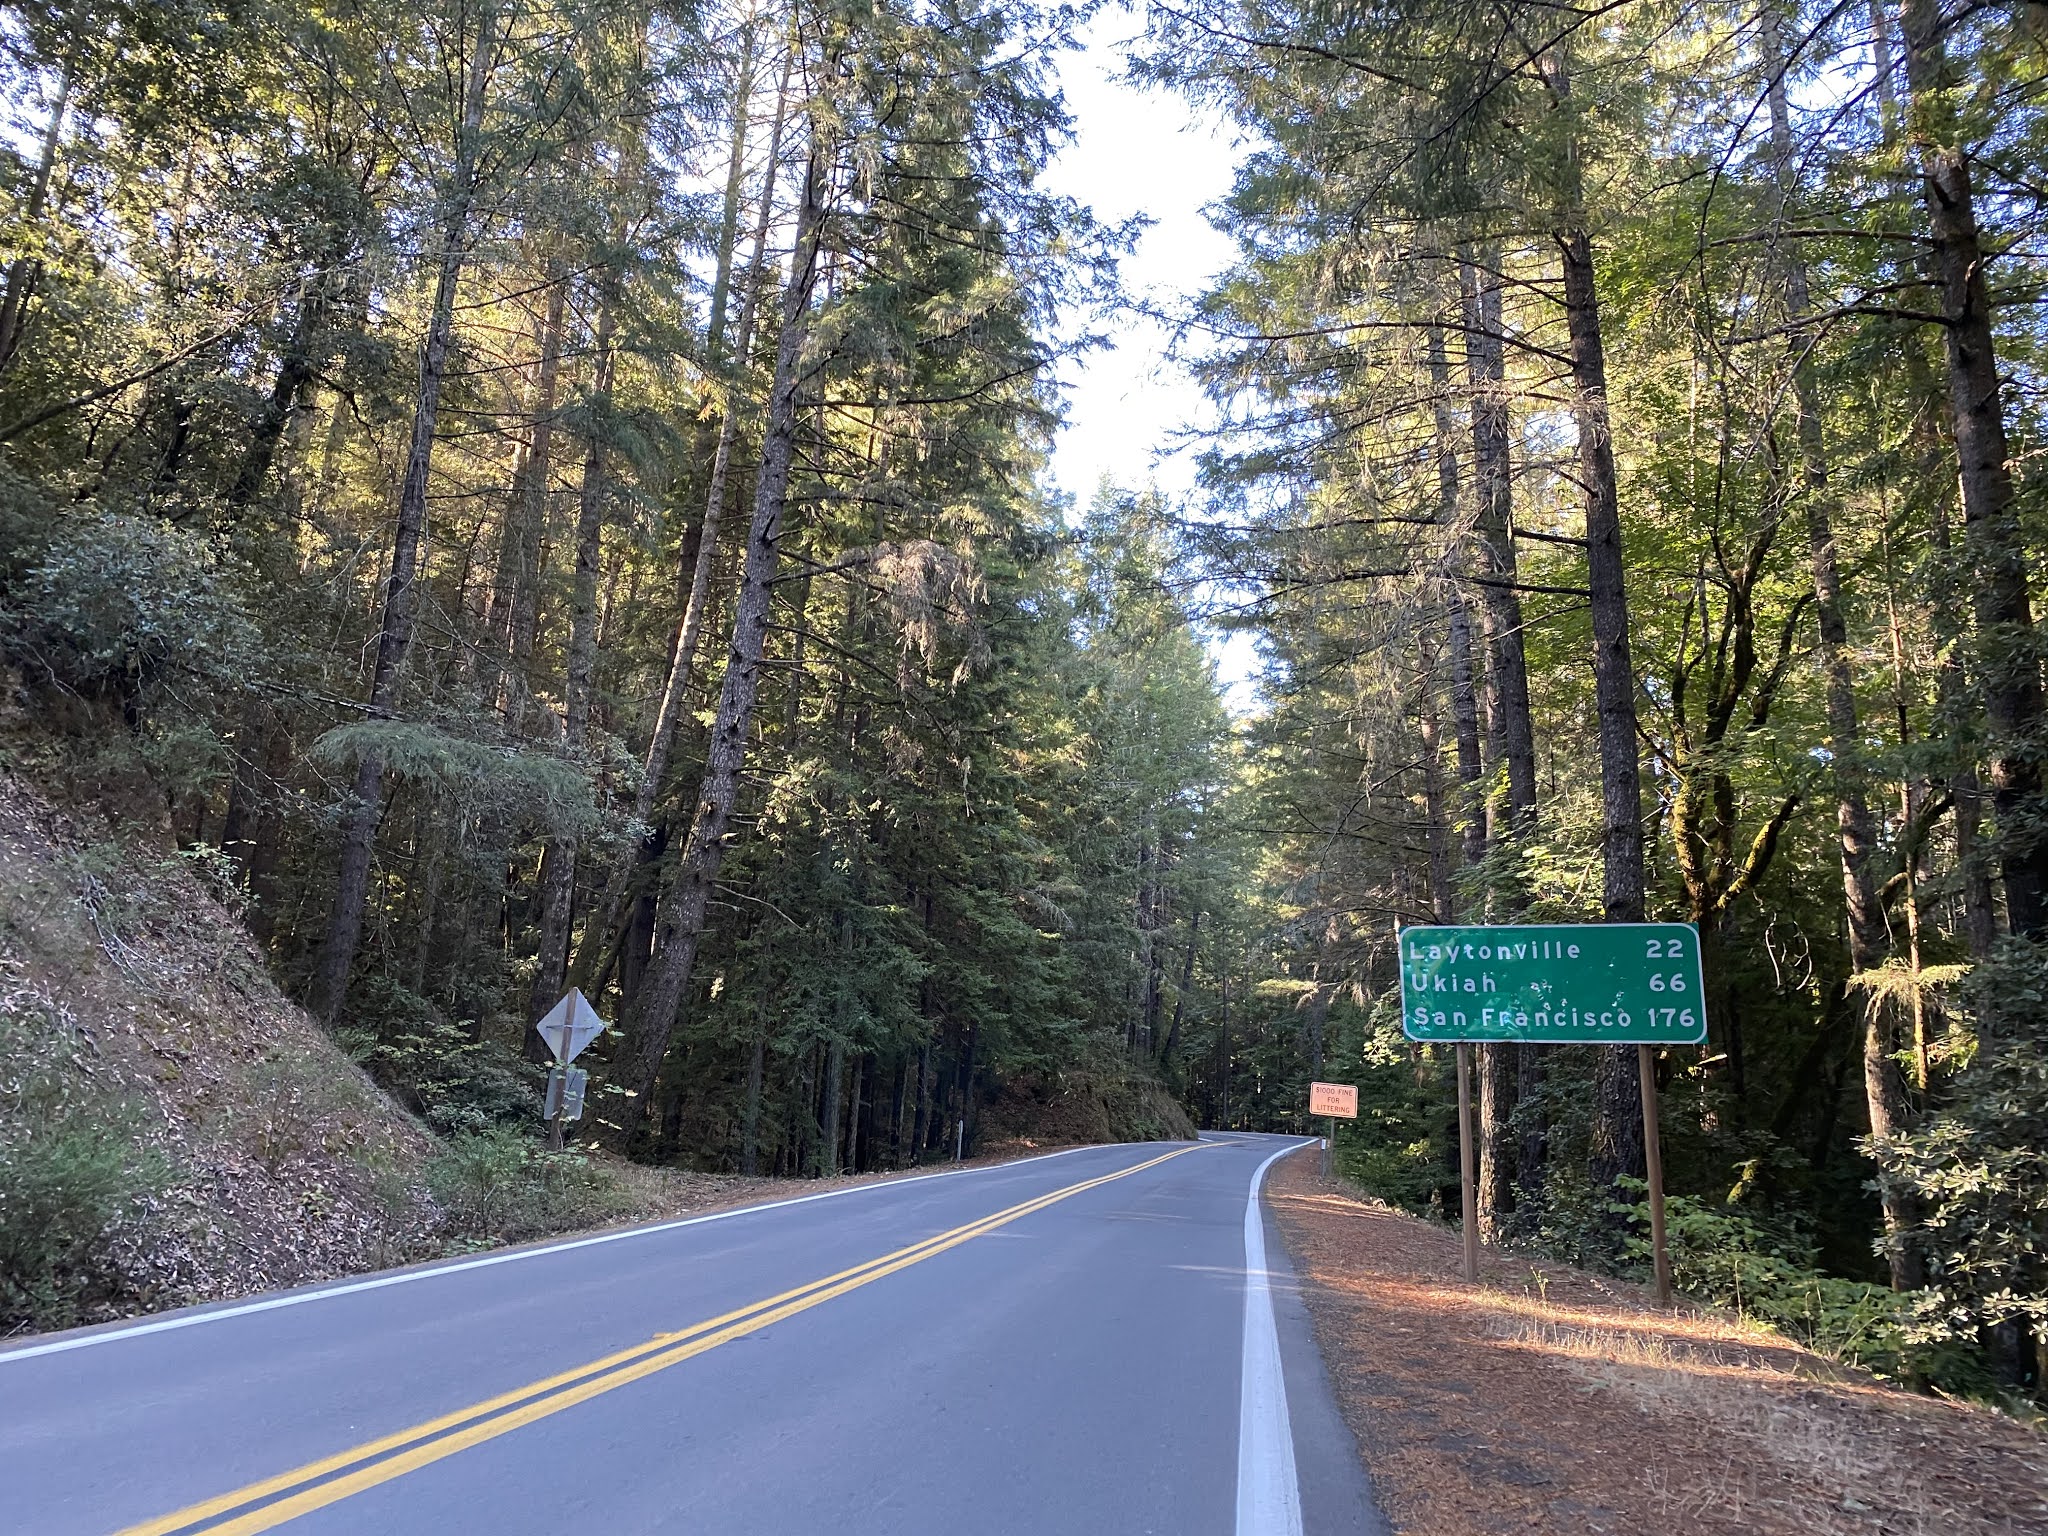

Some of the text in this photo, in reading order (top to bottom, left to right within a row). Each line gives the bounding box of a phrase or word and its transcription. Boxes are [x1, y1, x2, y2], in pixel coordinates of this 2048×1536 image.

[1409, 939, 1684, 964] Laytonville 22
[1411, 972, 1686, 992] Ukiah 66
[1414, 1007, 1696, 1028] San Francisco 176
[1317, 1105, 1350, 1113] LITTERING
